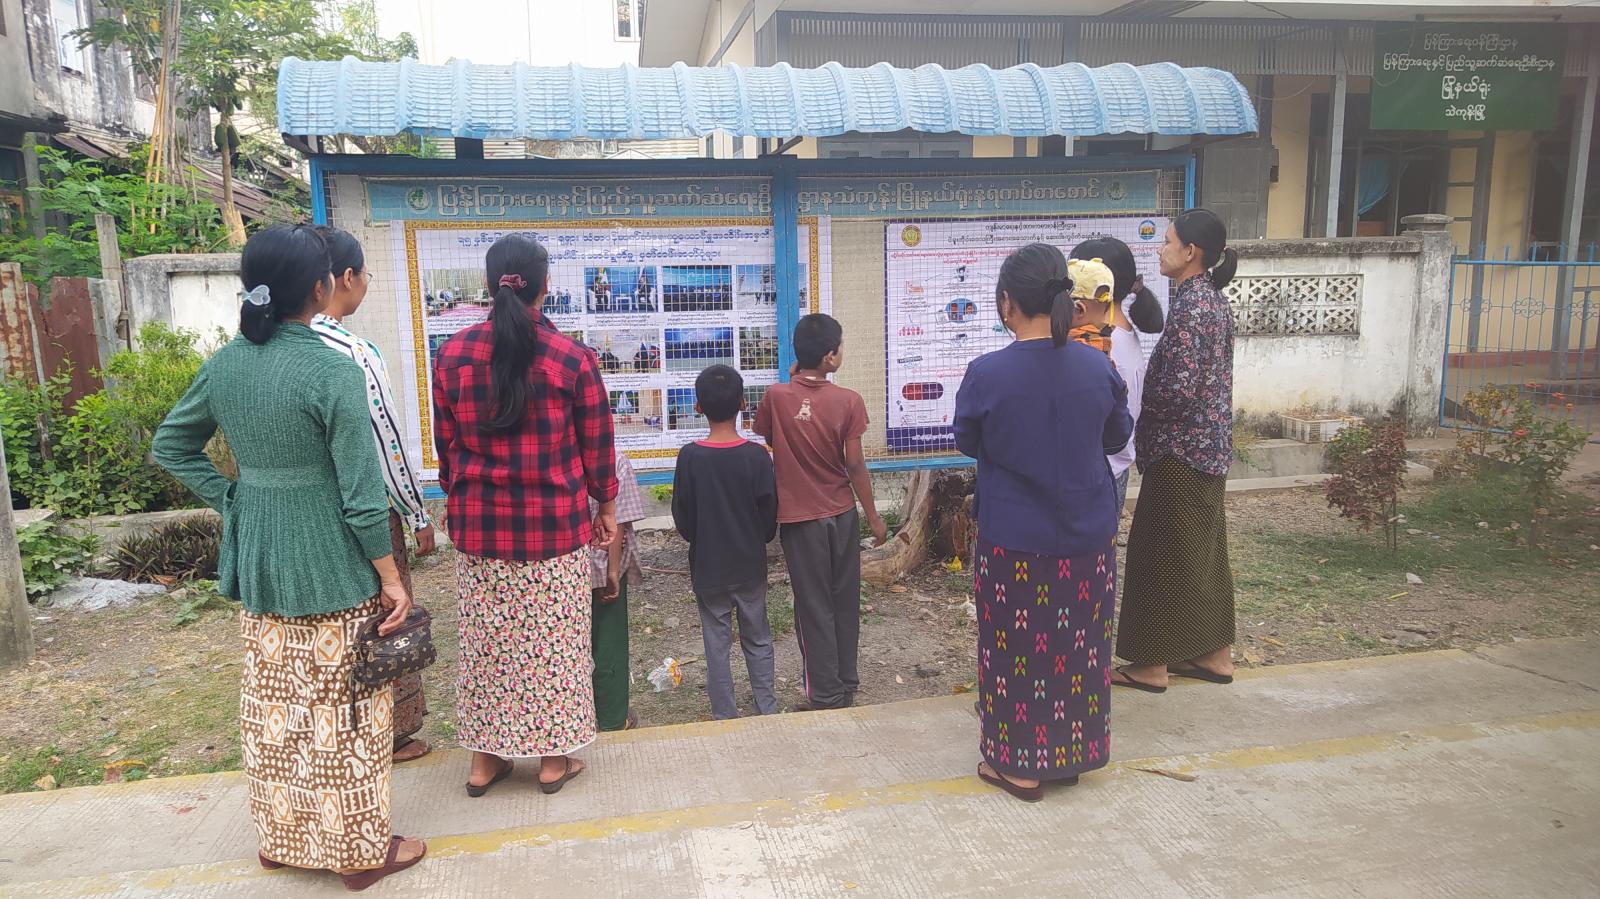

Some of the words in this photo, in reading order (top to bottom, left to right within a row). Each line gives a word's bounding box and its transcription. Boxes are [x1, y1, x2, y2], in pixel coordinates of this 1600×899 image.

[1441, 75, 1492, 100] မြို့နယ်ရုံး
